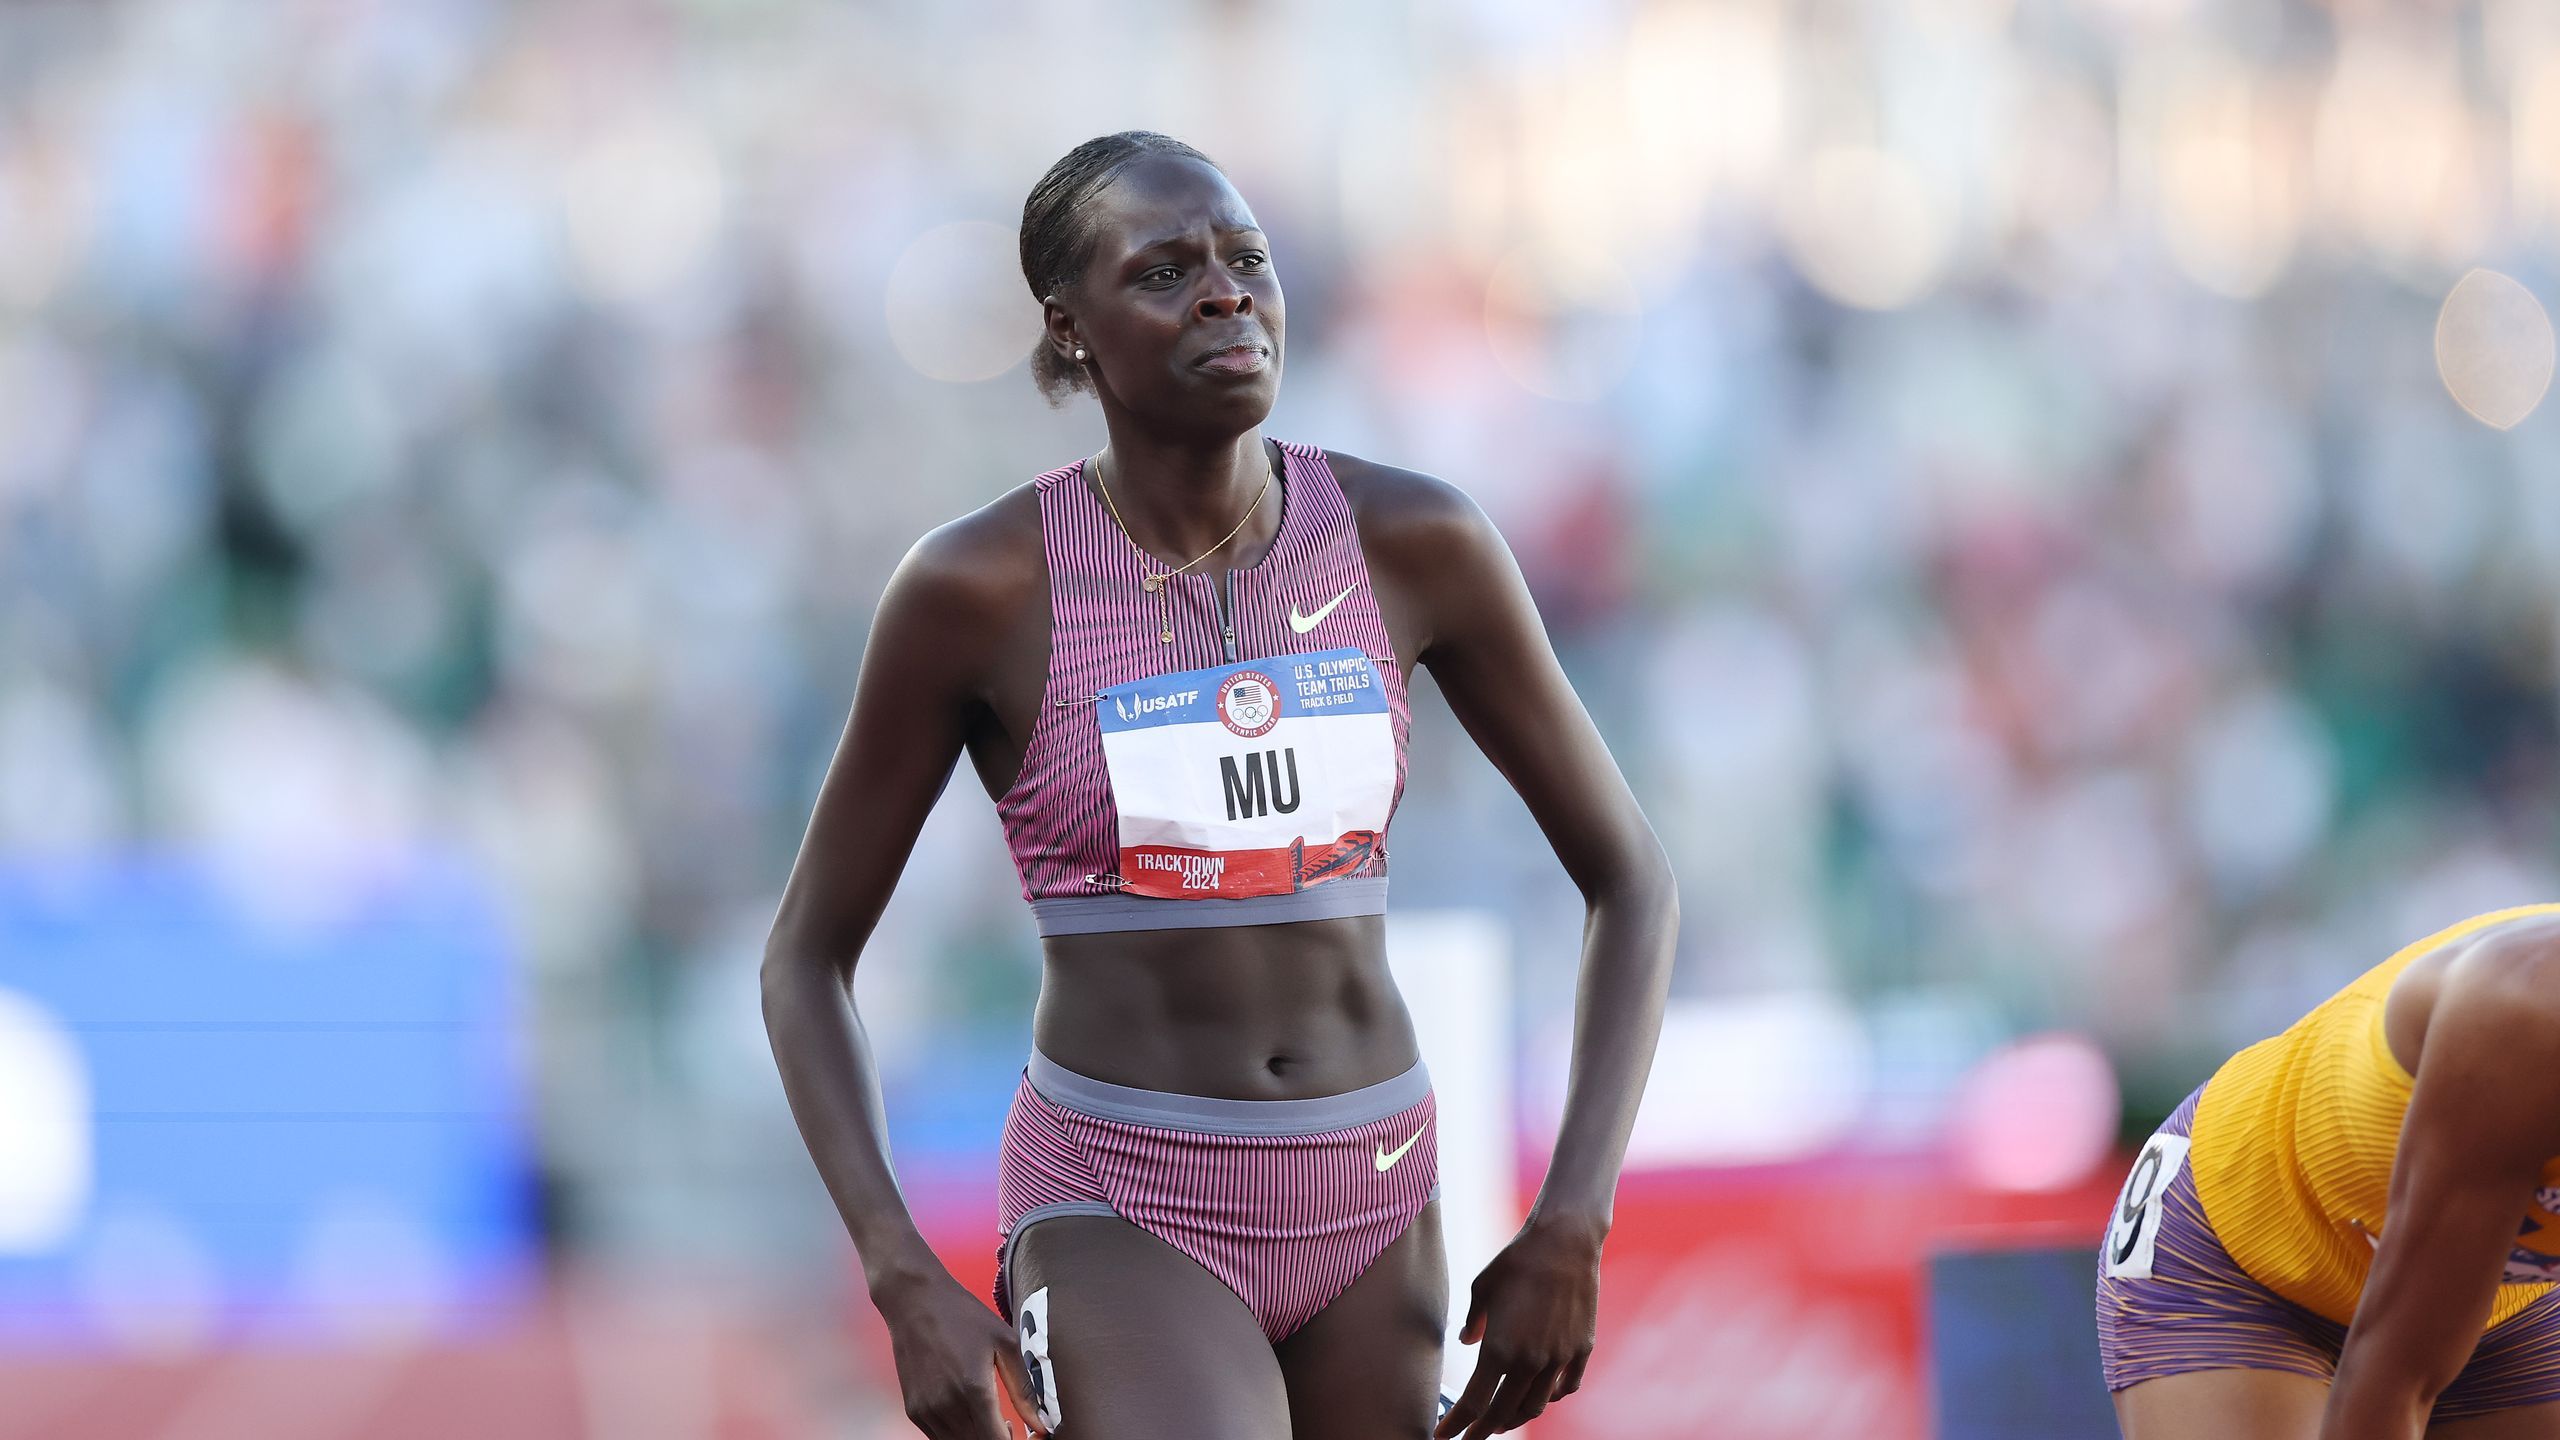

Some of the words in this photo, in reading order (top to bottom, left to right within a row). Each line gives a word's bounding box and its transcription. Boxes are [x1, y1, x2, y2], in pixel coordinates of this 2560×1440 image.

[1294, 664, 1316, 680] U.S.
[1318, 657, 1367, 677] OLYMPIC
[1220, 673, 1244, 694] UNITED
[1246, 672, 1272, 688] STATES
[1296, 679, 1327, 697] TEAM
[1329, 674, 1370, 692] TRIALS
[1142, 690, 1199, 713] USATF
[1300, 696, 1325, 709] TRACK
[1326, 695, 1333, 706] &
[1333, 692, 1354, 705] FIELD
[1227, 722, 1258, 737] OLYMPIC
[1260, 716, 1277, 733] TEAM
[1219, 747, 1301, 821] MU
[1135, 853, 1225, 875] TRACKTOWN
[1182, 871, 1220, 890] 2024
[2112, 1144, 2163, 1265] 9
